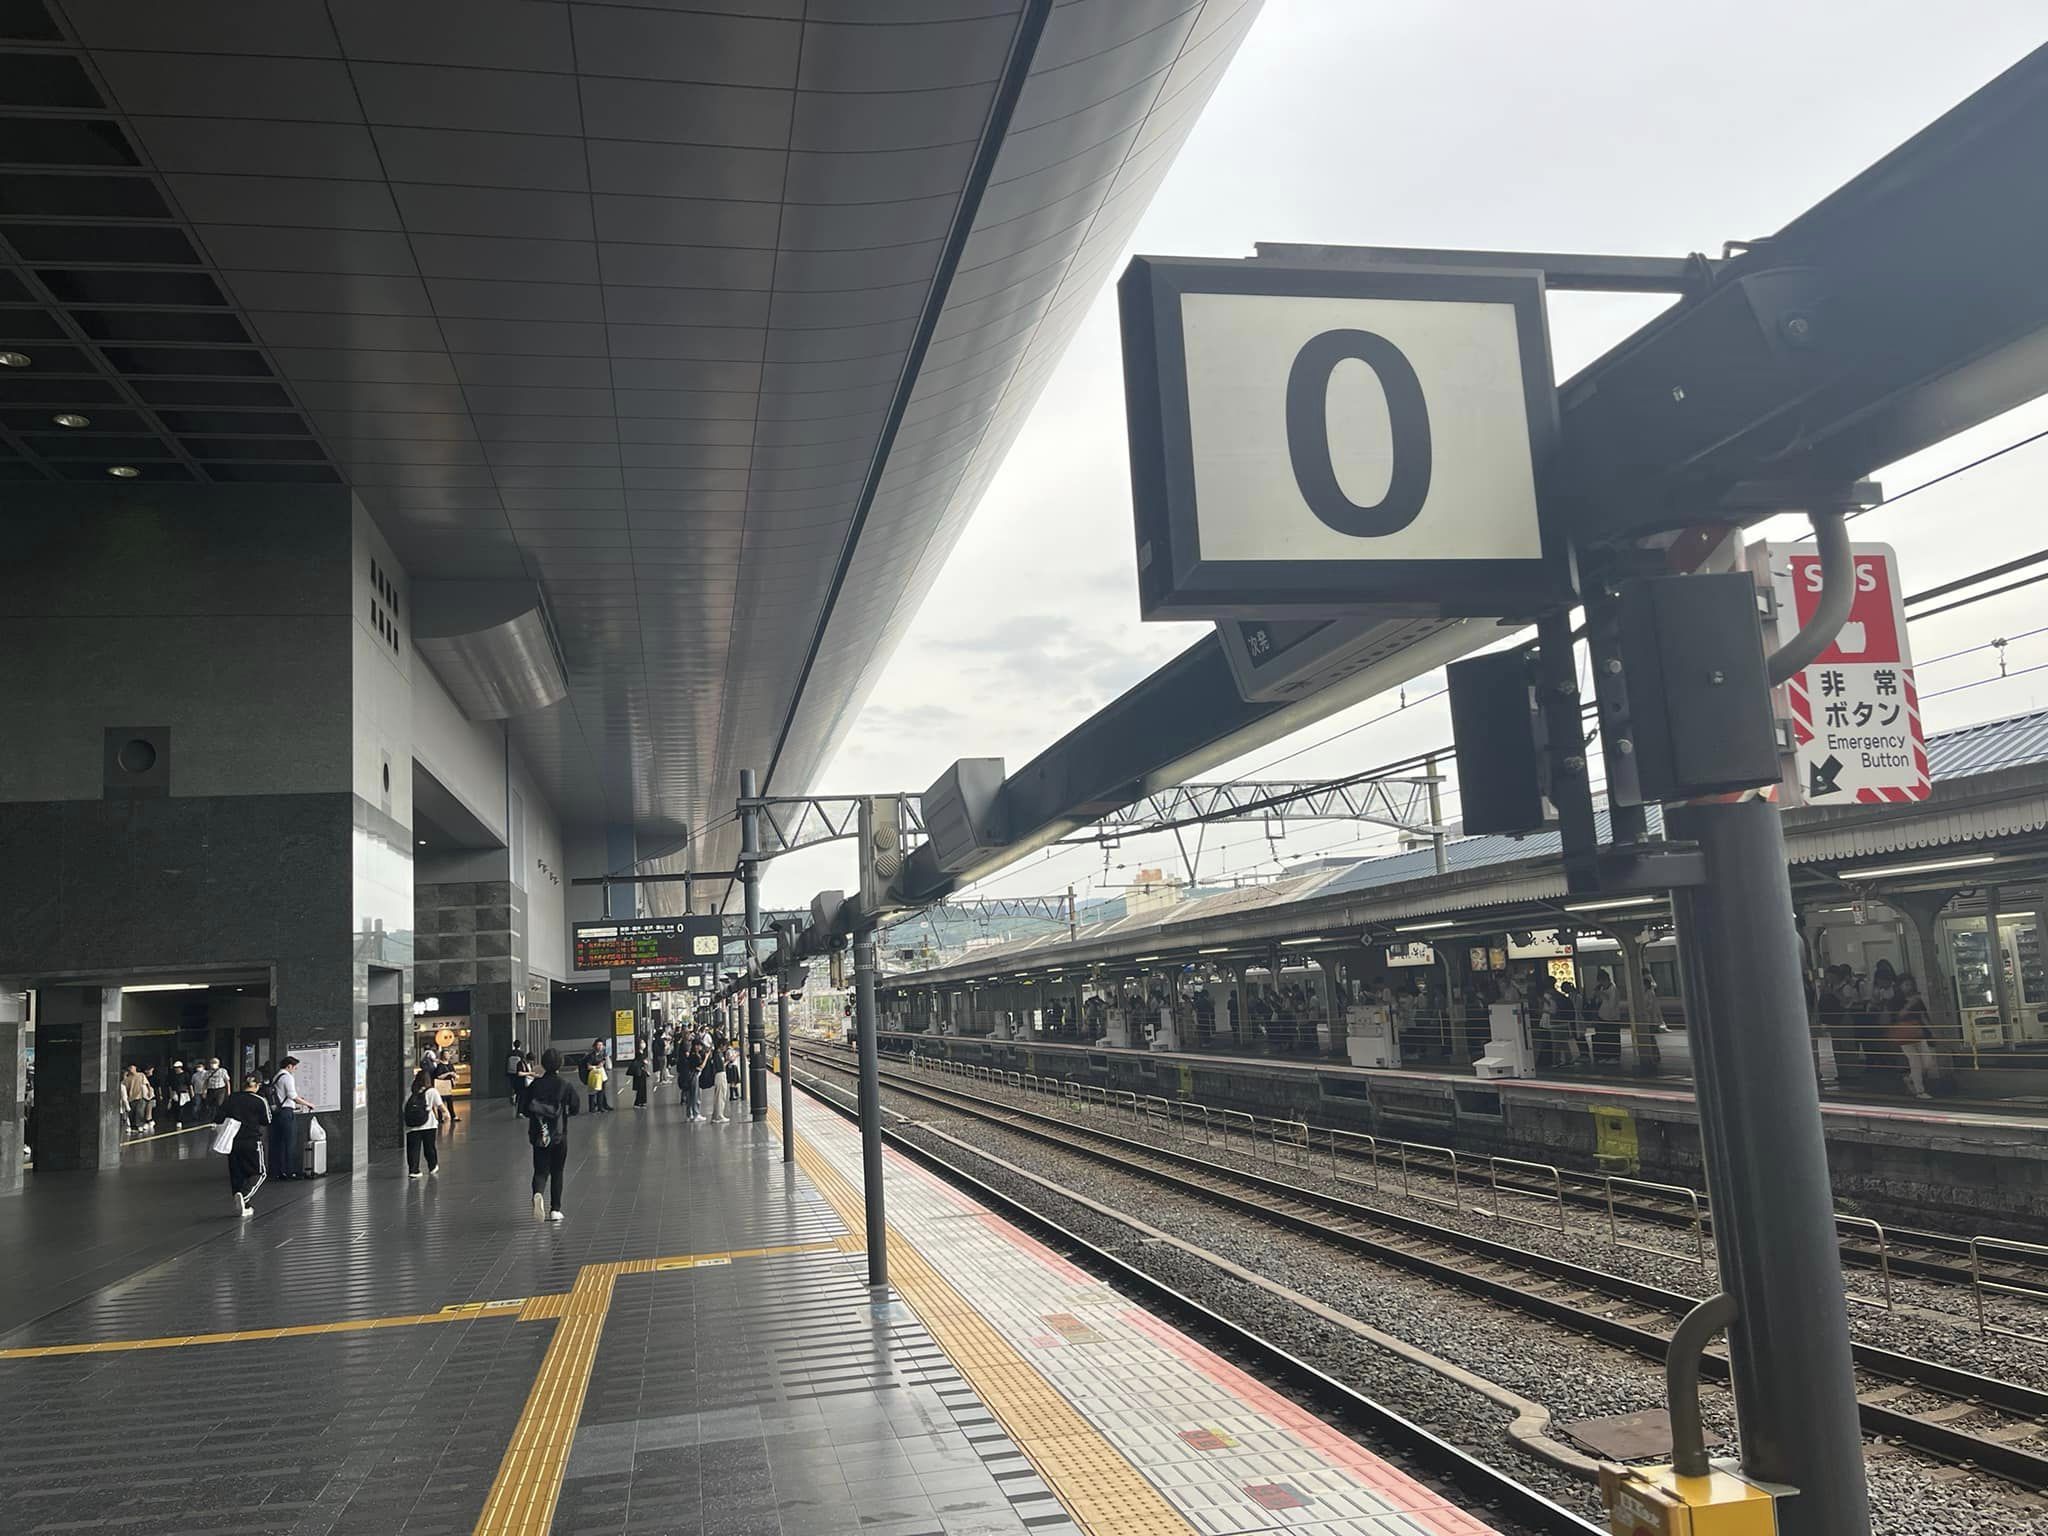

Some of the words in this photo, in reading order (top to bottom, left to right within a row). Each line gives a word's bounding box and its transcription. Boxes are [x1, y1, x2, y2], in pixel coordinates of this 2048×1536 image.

[1286, 328, 1432, 538] 0
[1804, 563, 1877, 592] SS
[1820, 670, 1897, 698] 非常
[1824, 701, 1901, 729] ボタン
[1827, 734, 1906, 752] Emergency
[1861, 753, 1910, 768] Button
